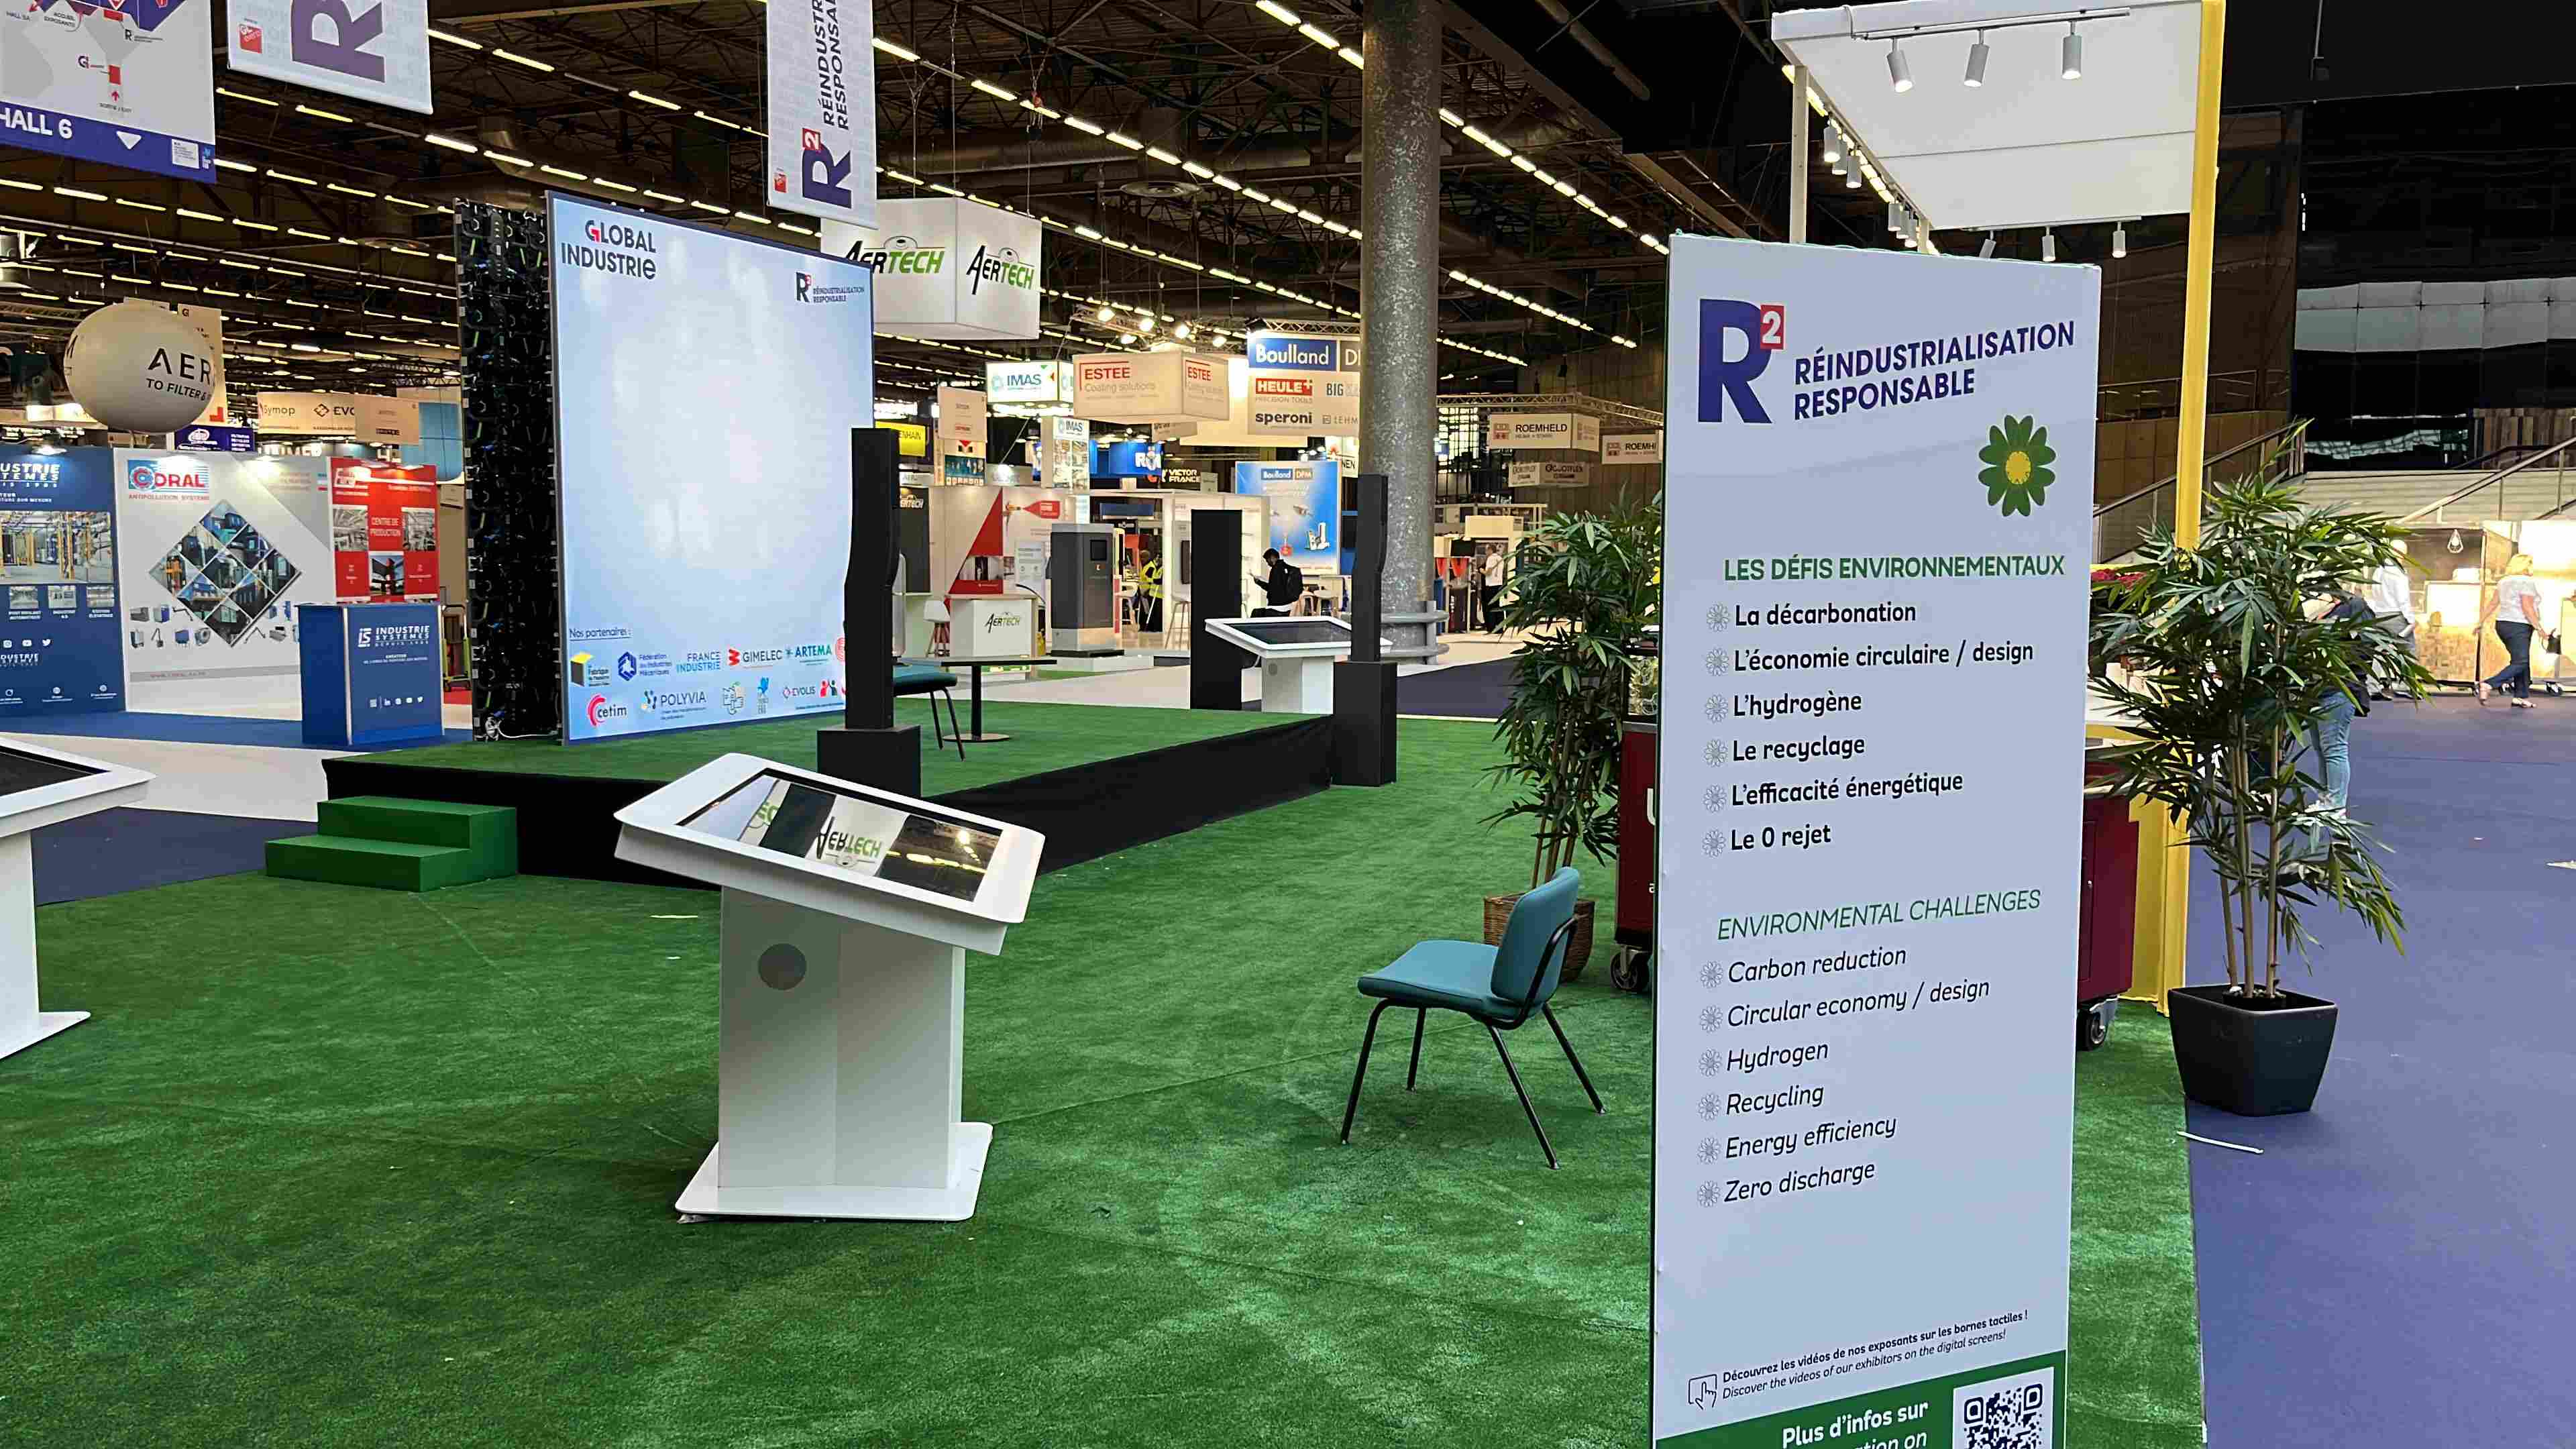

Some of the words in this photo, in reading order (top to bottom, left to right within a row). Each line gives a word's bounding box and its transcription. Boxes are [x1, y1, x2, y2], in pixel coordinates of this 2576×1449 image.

[58, 119, 72, 139] 6
[585, 219, 657, 253] GLOBAL
[966, 244, 1034, 295] AERTECH
[1256, 343, 1330, 365] Boulland
[1794, 321, 2075, 384] RÉINDUSTRIALISATION
[148, 347, 215, 387] AER
[1085, 367, 1131, 380] ESTEE
[1187, 366, 1212, 381] ESTEE
[146, 378, 164, 390] TO
[167, 383, 201, 399] FILTER
[1007, 374, 1042, 386] IMAS
[1085, 382, 1117, 392] Coating
[1257, 380, 1303, 393] HEULE
[1326, 383, 1344, 396] BIG
[1794, 368, 1976, 420] RESPONSABLE
[1065, 421, 1083, 432] IMAS
[1256, 411, 1313, 425] speroni
[1515, 423, 1568, 433] ROEMHELD
[133, 467, 205, 488] CORAL
[1724, 559, 1765, 581] LES
[1772, 553, 1833, 580] DÉFIS
[1839, 555, 2065, 579] ENVIRONNEMENTAUX
[1735, 606, 1760, 627] La
[1766, 602, 1917, 626] décarbonation
[376, 625, 430, 635] INDUSTRIE
[376, 633, 429, 641] SYSTEMES
[570, 628, 584, 638] Nos
[687, 651, 722, 662] FRANCE
[743, 649, 784, 663] GIMELEC
[795, 644, 833, 658] ARTEMA
[1856, 643, 1949, 666] circulaire
[1972, 641, 2034, 663] design
[676, 661, 722, 674] INDUSTRIE
[660, 692, 708, 706] POLYVIA
[792, 686, 816, 696] EVOLIS
[597, 704, 628, 718] cetim
[1733, 740, 1756, 761] Le
[1763, 735, 1866, 761] recyclage
[1845, 771, 1964, 799] énergétique
[1731, 829, 1755, 851] Le
[1762, 826, 1774, 848] 0
[1782, 824, 1831, 850] rejet
[1718, 903, 1904, 940] ENVIRONMENTAL
[1909, 889, 2041, 922] CHALLENGES
[1728, 958, 1806, 983] Carbon
[1812, 947, 1907, 973] reduction
[1727, 1001, 1811, 1028] Circular
[1816, 990, 1907, 1016] economy
[1929, 979, 1990, 1003] design
[1727, 1041, 1829, 1073] Hydrogen
[1726, 1085, 1825, 1116] Recycling
[1725, 1130, 1797, 1159] Energy
[1804, 1116, 1897, 1146] efficiency
[1724, 1179, 1772, 1203] Zero
[1778, 1162, 1876, 1194] discharge
[1723, 1364, 1778, 1383] Découvrez
[1781, 1360, 1796, 1371] les
[1798, 1352, 1831, 1366] vidéos
[1833, 1348, 1846, 1360] de
[1848, 1344, 1866, 1356] nos
[1868, 1334, 1918, 1353] exposants
[1920, 1330, 1937, 1342] sur
[1938, 1326, 1952, 1338] les
[1954, 1319, 1986, 1334] bornes
[1989, 1312, 2023, 1328] tactiles
[1723, 1381, 1768, 1400] Discover
[1770, 1377, 1786, 1390] the
[1788, 1370, 1821, 1385] videos
[1823, 1364, 1835, 1377] of
[1836, 1362, 1854, 1375] our
[1855, 1350, 1902, 1371] exhibitors
[1904, 1349, 1917, 1360] on
[1919, 1344, 1935, 1357] the
[1937, 1337, 1966, 1353] digital
[1782, 1426, 1825, 1449] Plus
[1897, 1401, 1929, 1423] sur
[1904, 1431, 1927, 1449] on
